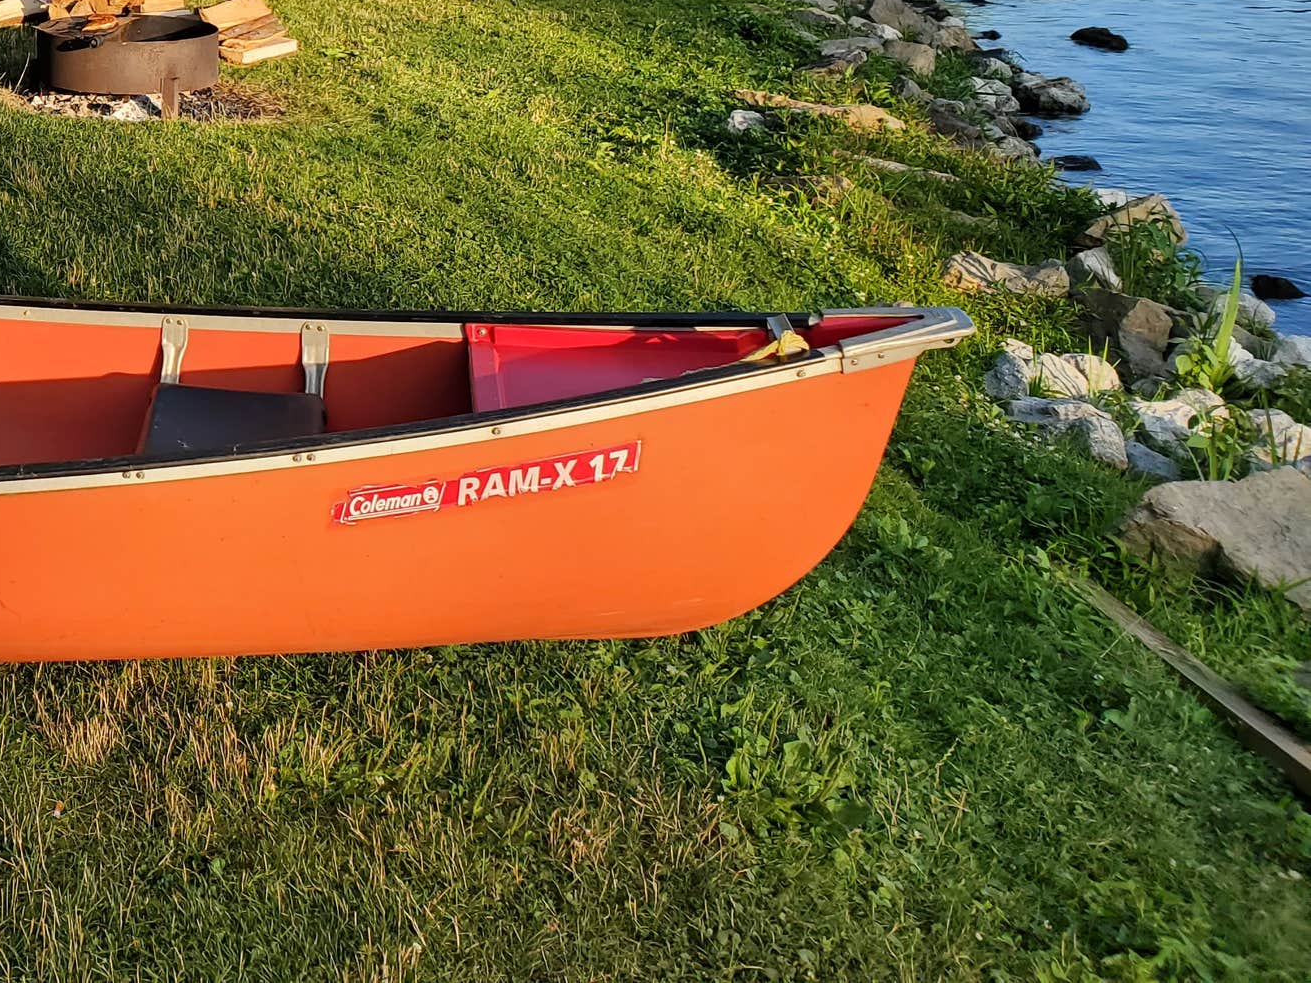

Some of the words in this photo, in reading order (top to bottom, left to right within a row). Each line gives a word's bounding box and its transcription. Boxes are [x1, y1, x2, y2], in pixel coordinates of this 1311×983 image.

[349, 493, 422, 516] Coleman
[458, 459, 577, 506] RAM-X
[589, 449, 629, 482] 17
